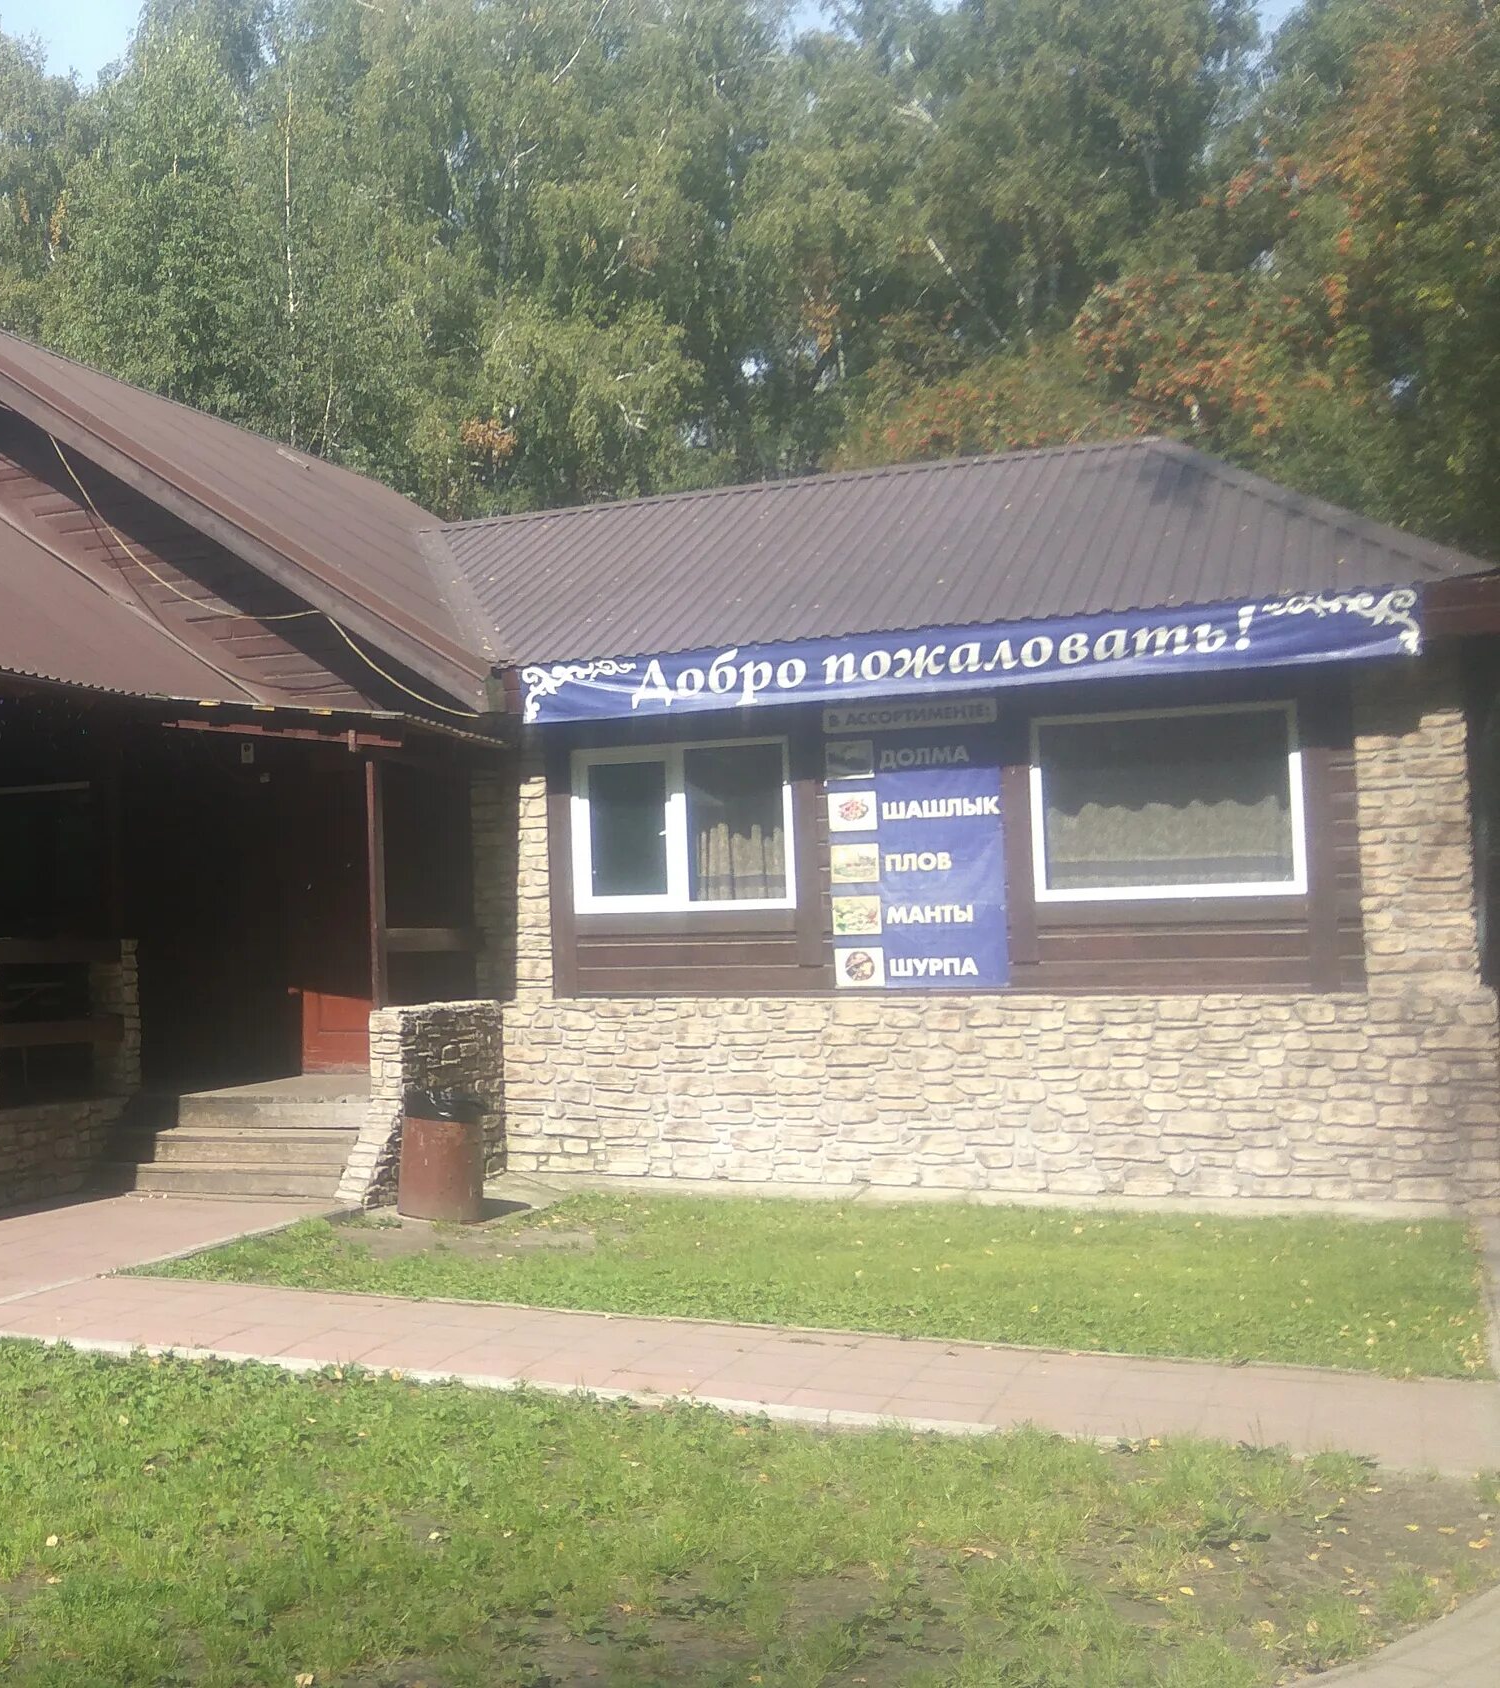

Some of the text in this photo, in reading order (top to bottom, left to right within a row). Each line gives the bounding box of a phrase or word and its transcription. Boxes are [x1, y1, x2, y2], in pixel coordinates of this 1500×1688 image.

[632, 605, 1256, 709] Добро пожаловать!
[845, 703, 991, 726] АССОРТИМЕНТЕ:
[879, 744, 970, 771] ДОЛМА
[881, 795, 1001, 820] ШАШЛЫК
[884, 851, 952, 872] ПЛОВ
[886, 904, 974, 925] МАНТЫ
[889, 956, 979, 978] ШУРПА
